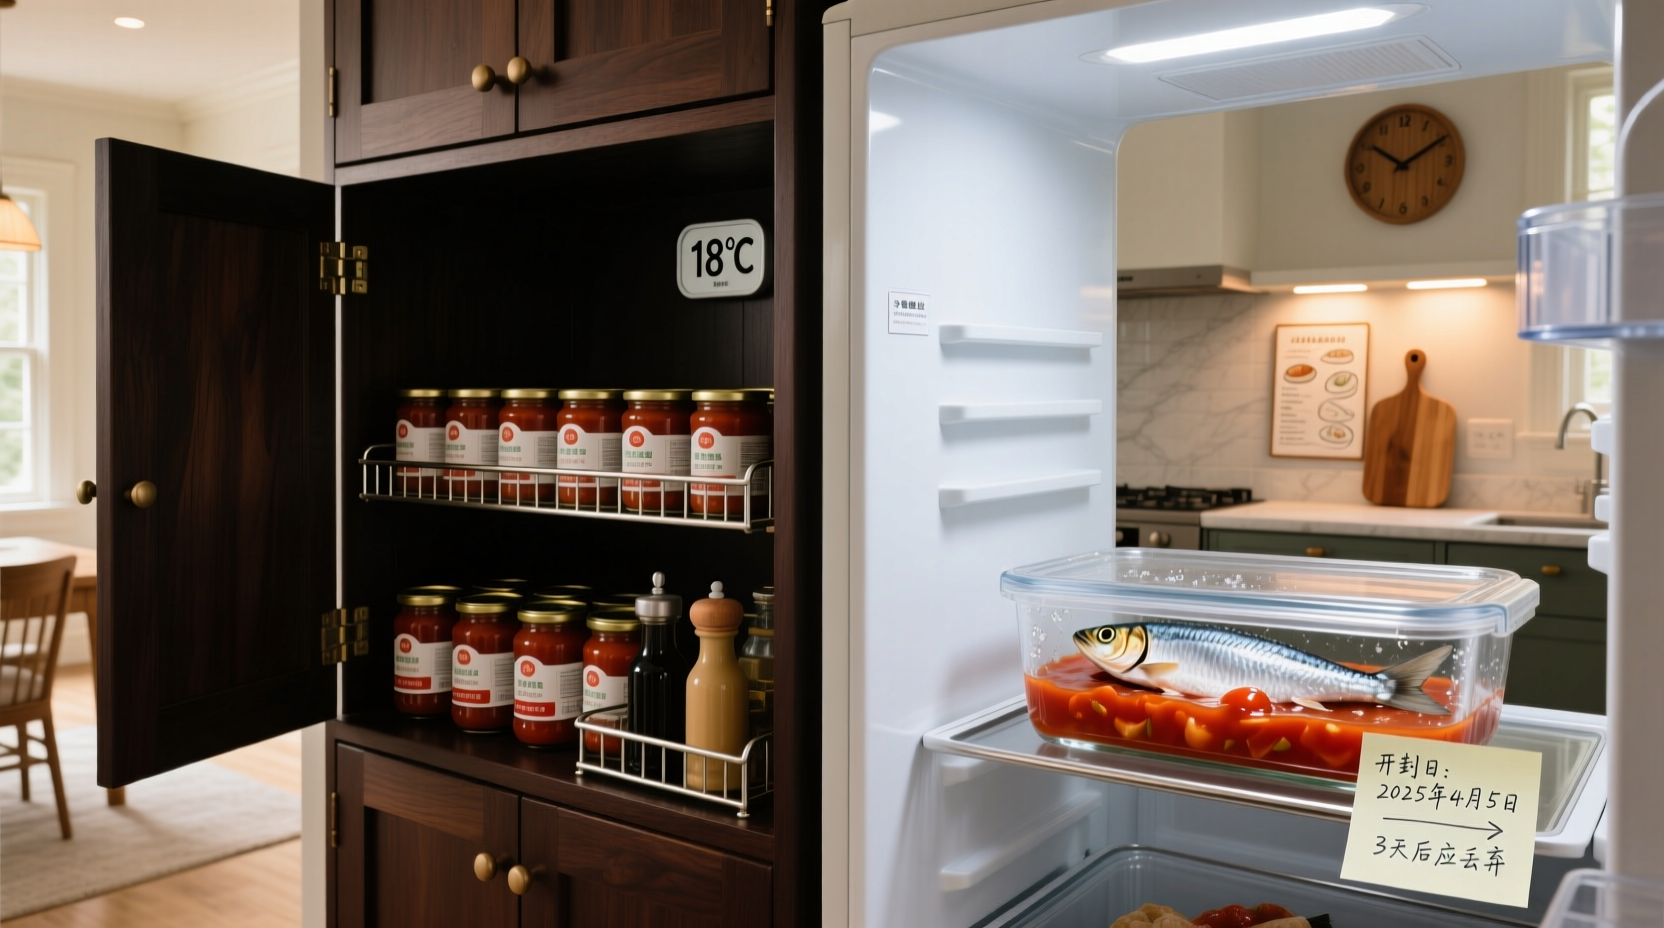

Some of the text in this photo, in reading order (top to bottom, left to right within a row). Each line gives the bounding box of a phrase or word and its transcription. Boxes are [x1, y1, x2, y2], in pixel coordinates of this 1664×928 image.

[1399, 115, 1411, 128] 12
[691, 236, 754, 278] 18°C
[1375, 752, 1449, 779] 开封日：
[1376, 782, 1518, 813] 2025年4月5日
[1373, 835, 1505, 877] 3天后应丢弃
